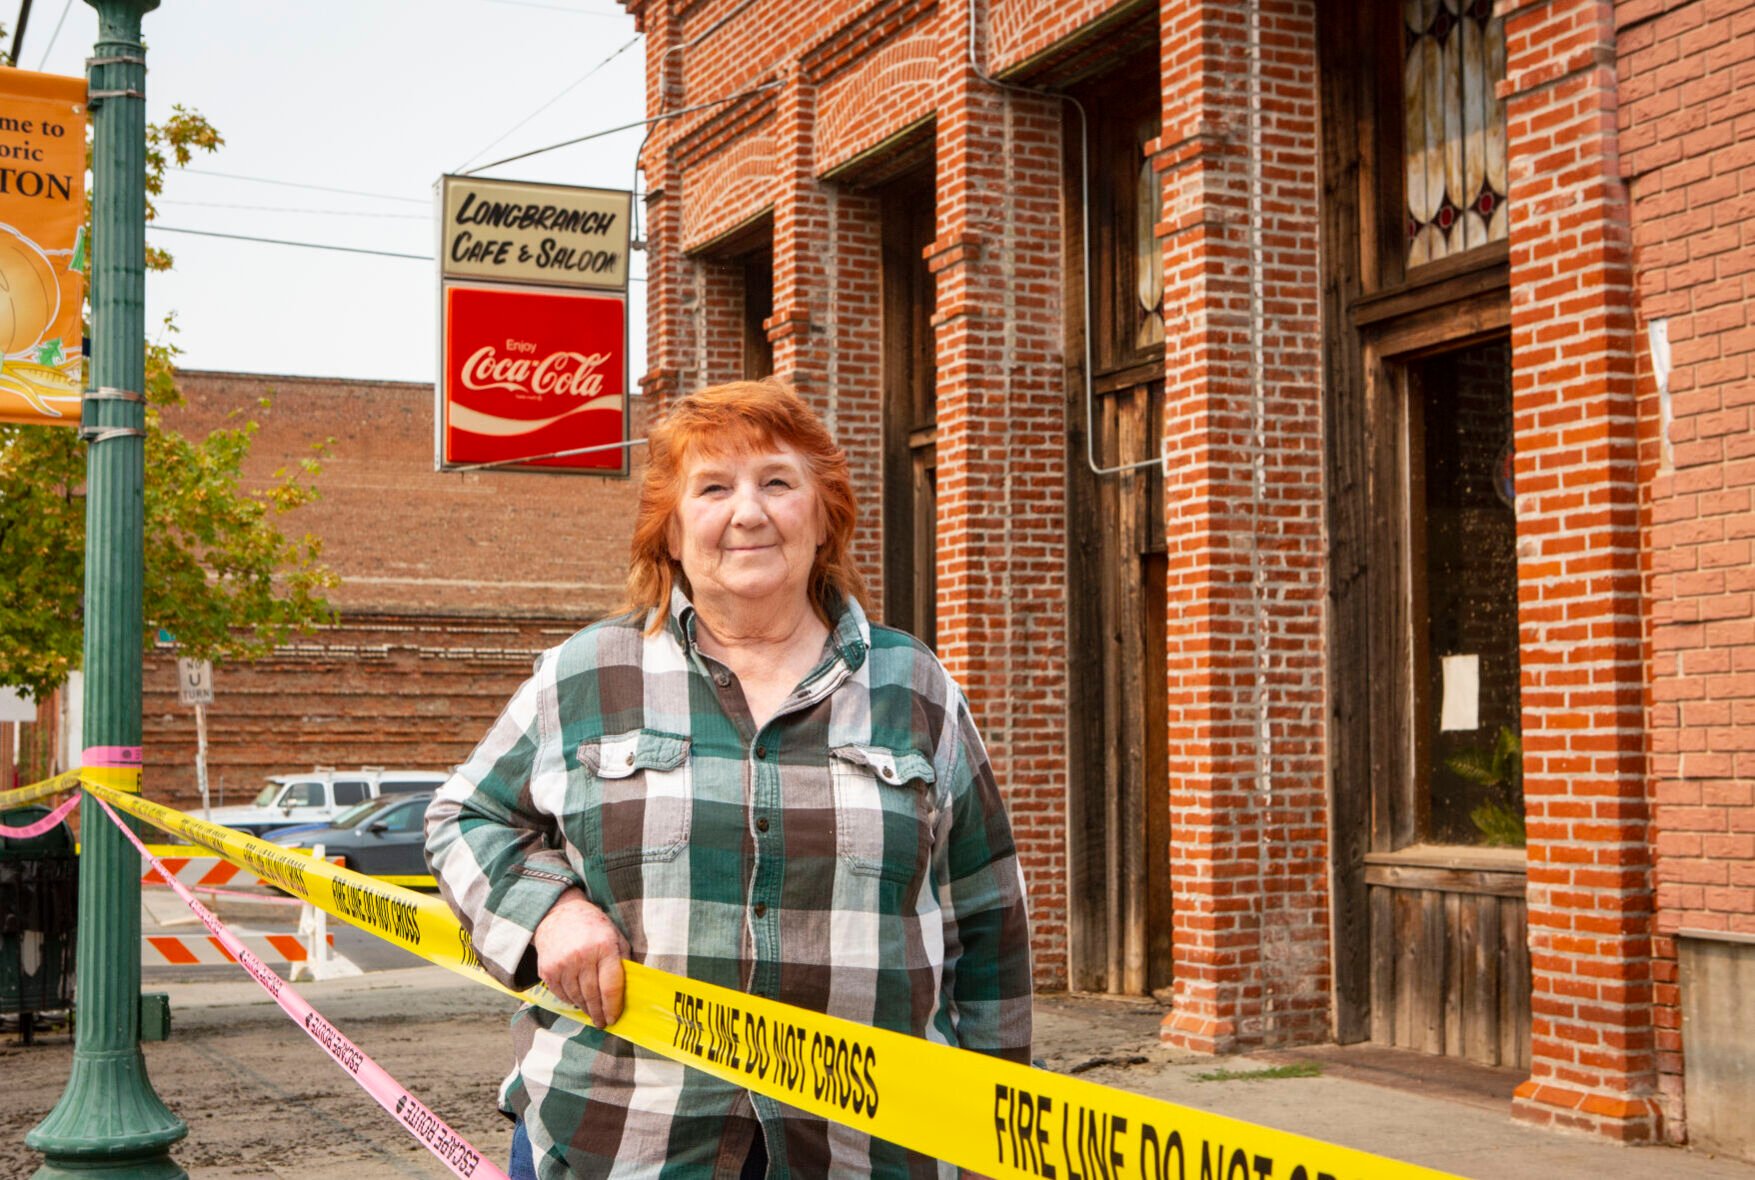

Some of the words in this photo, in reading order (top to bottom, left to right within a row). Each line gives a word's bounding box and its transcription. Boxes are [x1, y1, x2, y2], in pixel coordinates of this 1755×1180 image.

[41, 120, 65, 138] to
[455, 192, 616, 236] LONGBRANCH
[451, 230, 514, 265] CAFE
[517, 244, 533, 263] &
[506, 338, 537, 354] Enjoy
[461, 346, 612, 397] Coca-Cola
[189, 672, 201, 687] U
[673, 991, 704, 1057] FIRE
[707, 1001, 740, 1069] LINE
[745, 1011, 770, 1080] DO
[773, 1020, 806, 1094] NOT
[811, 1031, 879, 1119] CROSS
[403, 1101, 440, 1143] ROUTE
[994, 1083, 1055, 1180] FIRE
[1062, 1102, 1128, 1180] LINE
[1140, 1122, 1185, 1180] DO
[433, 1128, 480, 1178] ESCAPE
